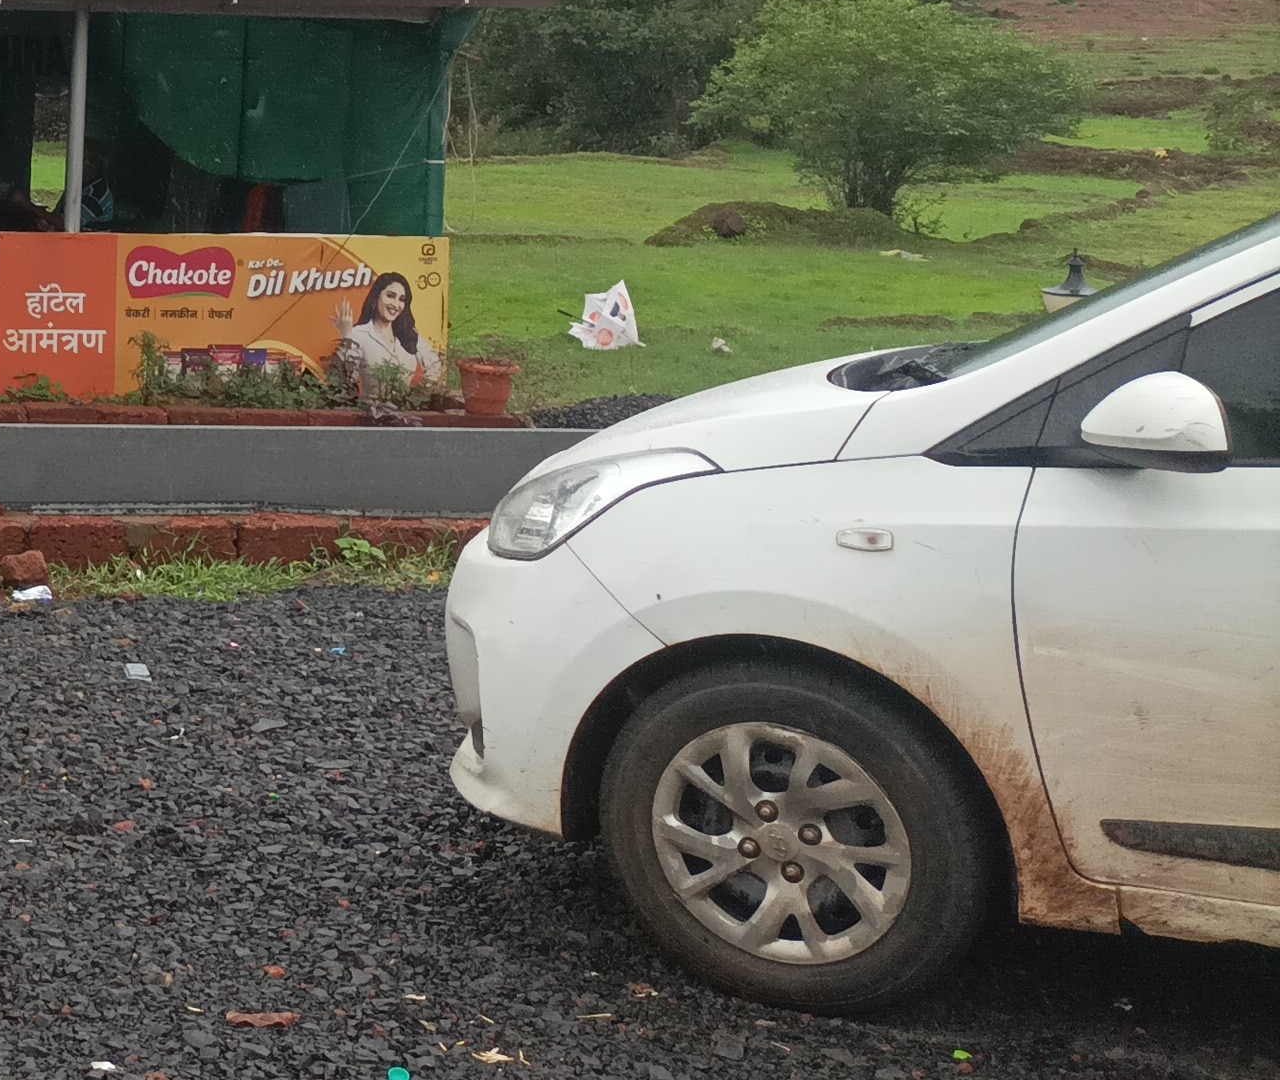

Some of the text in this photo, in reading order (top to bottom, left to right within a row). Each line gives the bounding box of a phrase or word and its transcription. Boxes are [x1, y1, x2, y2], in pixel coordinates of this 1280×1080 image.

[129, 260, 232, 287] Chakote
[248, 259, 265, 269] Kar
[247, 263, 372, 297] Dil Khush
[25, 283, 86, 318] हॉटेल
[160, 307, 199, 319] नमकीन
[2, 322, 107, 354] आमंत्रण
